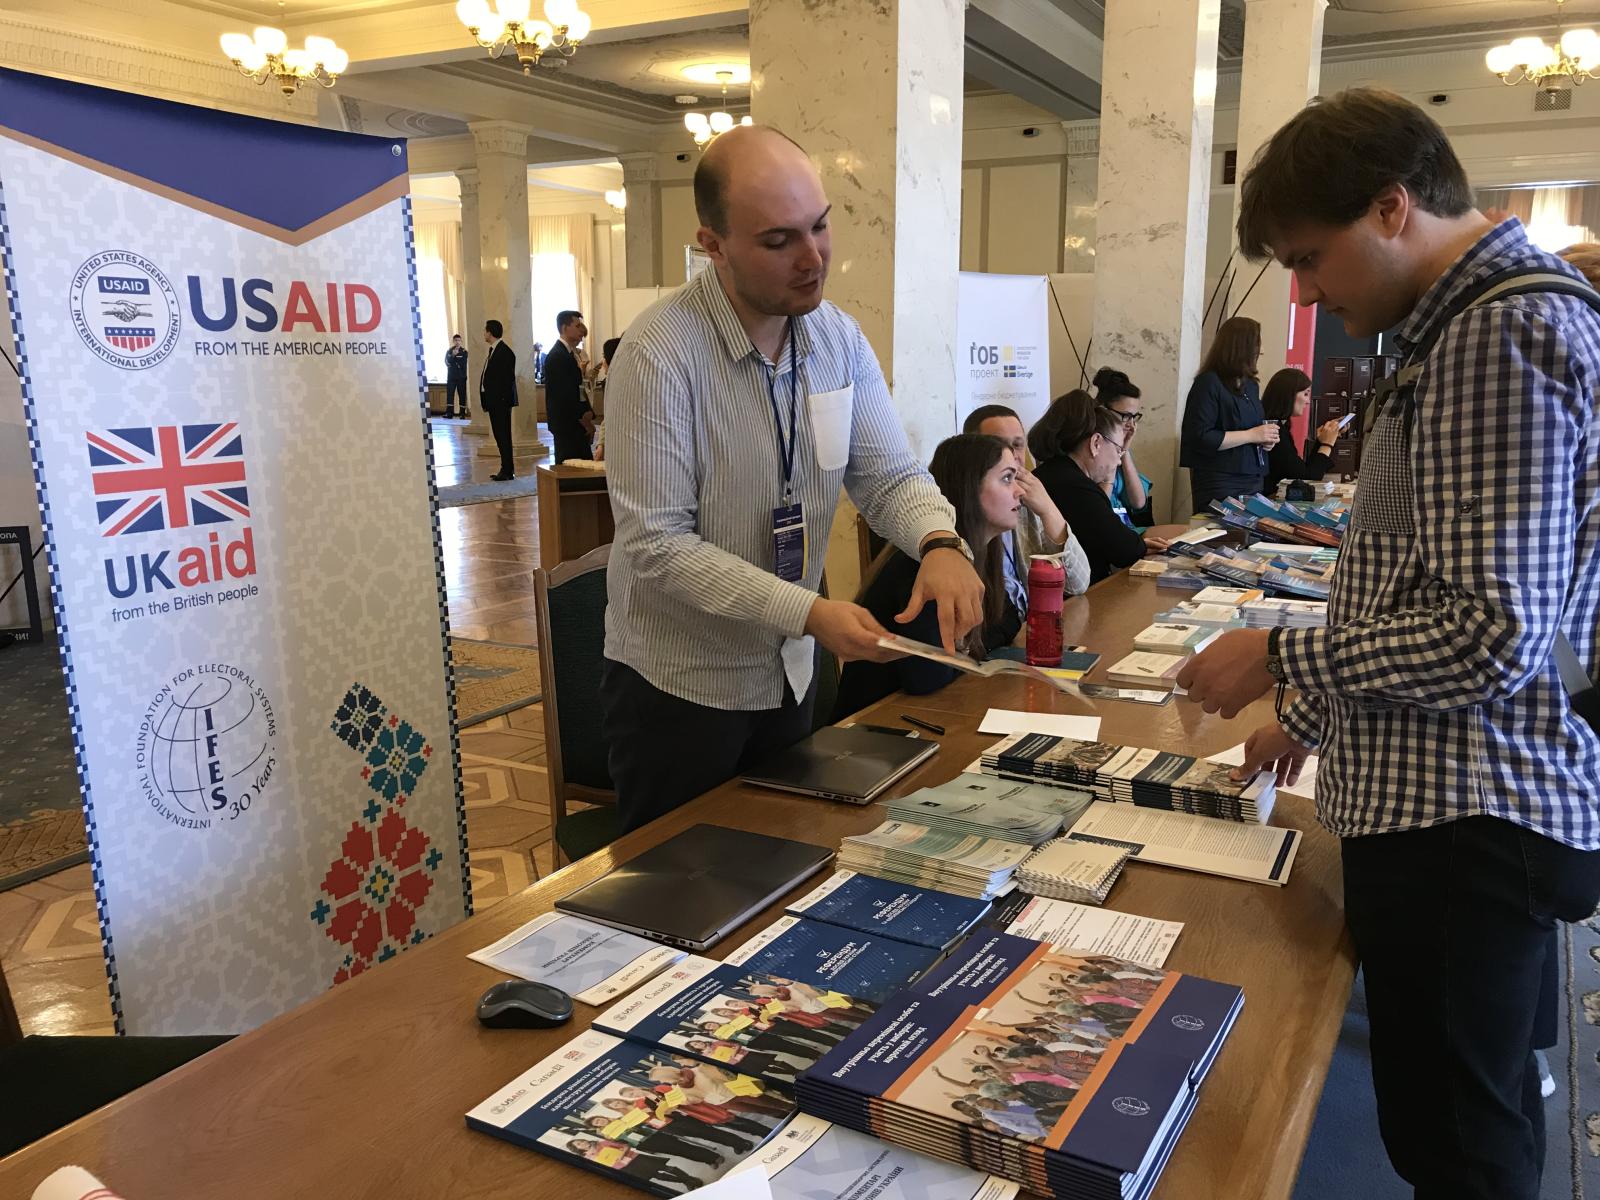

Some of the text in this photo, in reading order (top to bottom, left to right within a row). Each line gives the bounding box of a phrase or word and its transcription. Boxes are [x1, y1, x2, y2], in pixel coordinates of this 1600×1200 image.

[74, 253, 172, 293] UNITED STATES AGENCY
[103, 279, 145, 292] USAID
[187, 275, 382, 333] USAID
[73, 309, 179, 368] INTERNATIONAL DEVELOPMENT
[195, 342, 387, 356] FROM THE AMERICAN PEOPLE
[970, 369, 999, 380] проект
[0, 532, 17, 540] ОПА
[112, 584, 259, 622] from the British people
[136, 663, 276, 829] INTERNATIONAL FOUNDATION FOR ELECTORAL SYSTEMS
[204, 707, 228, 811] IFES
[229, 756, 276, 820] 30 Years
[815, 941, 857, 973] РЕФЕРЕНДУМ
[644, 981, 674, 1000] Canada
[623, 1001, 642, 1018] USAID
[832, 1046, 871, 1078] Внутрішньо
[867, 1020, 901, 1048] переміщені
[897, 1007, 915, 1022] особи
[867, 1045, 890, 1063] участь
[883, 1039, 912, 1064] короткий
[908, 1026, 927, 1041] огляд
[529, 1063, 565, 1087] Canada
[567, 1073, 591, 1091] рівність
[501, 1089, 526, 1107] USAID
[551, 1077, 597, 1112] адміністрування
[761, 1145, 790, 1164] Canada
[877, 1166, 904, 1189] УКРАЇНИ
